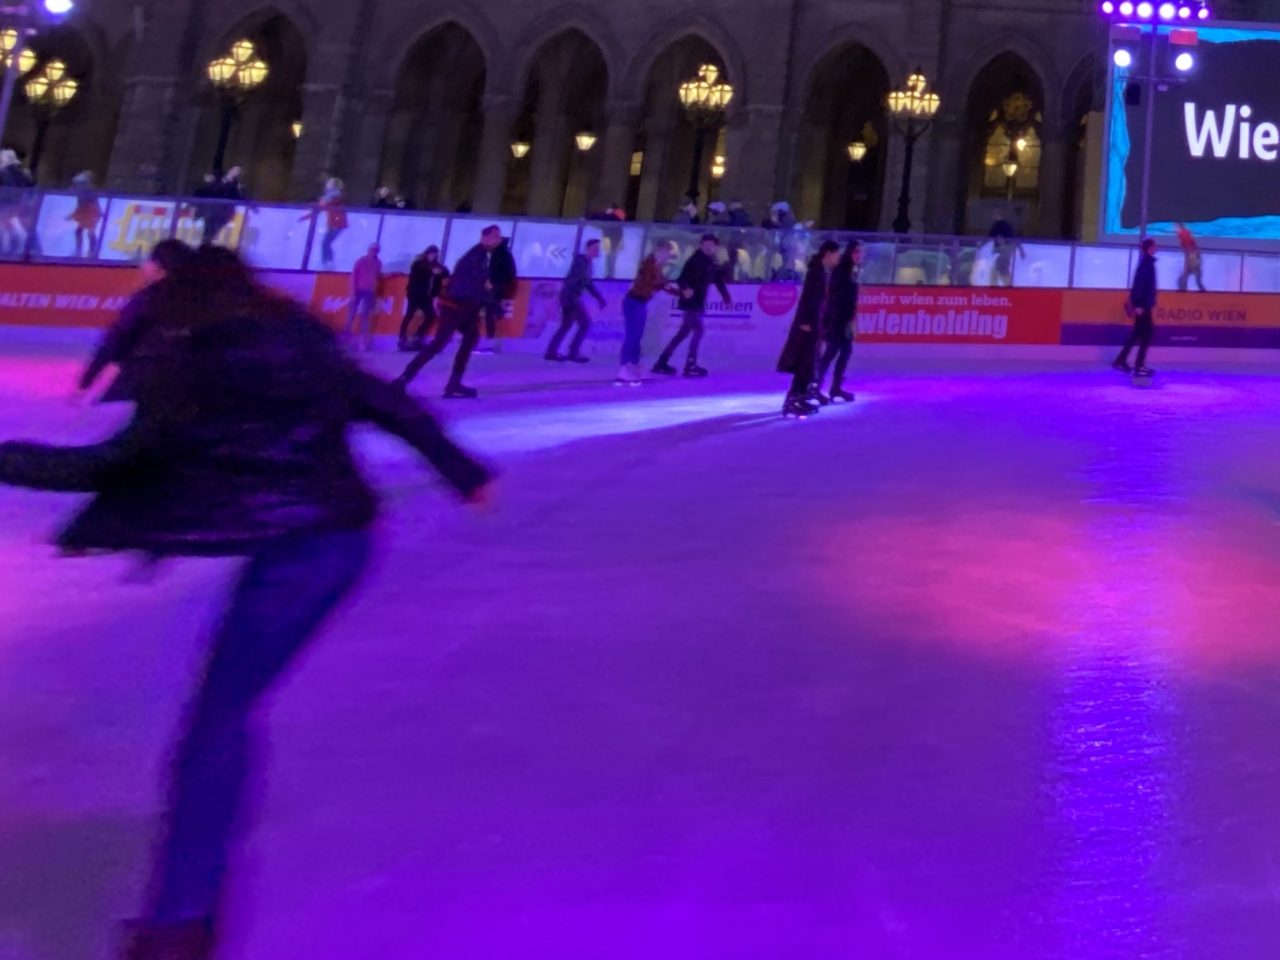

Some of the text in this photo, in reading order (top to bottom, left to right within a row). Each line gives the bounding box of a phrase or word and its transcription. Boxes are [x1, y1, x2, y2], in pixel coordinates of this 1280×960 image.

[0, 292, 52, 307] ALTEN
[54, 294, 100, 309] WIEN
[858, 292, 1012, 307] mehr wien zum leben.
[1156, 308, 1247, 321] RADIO WIEN
